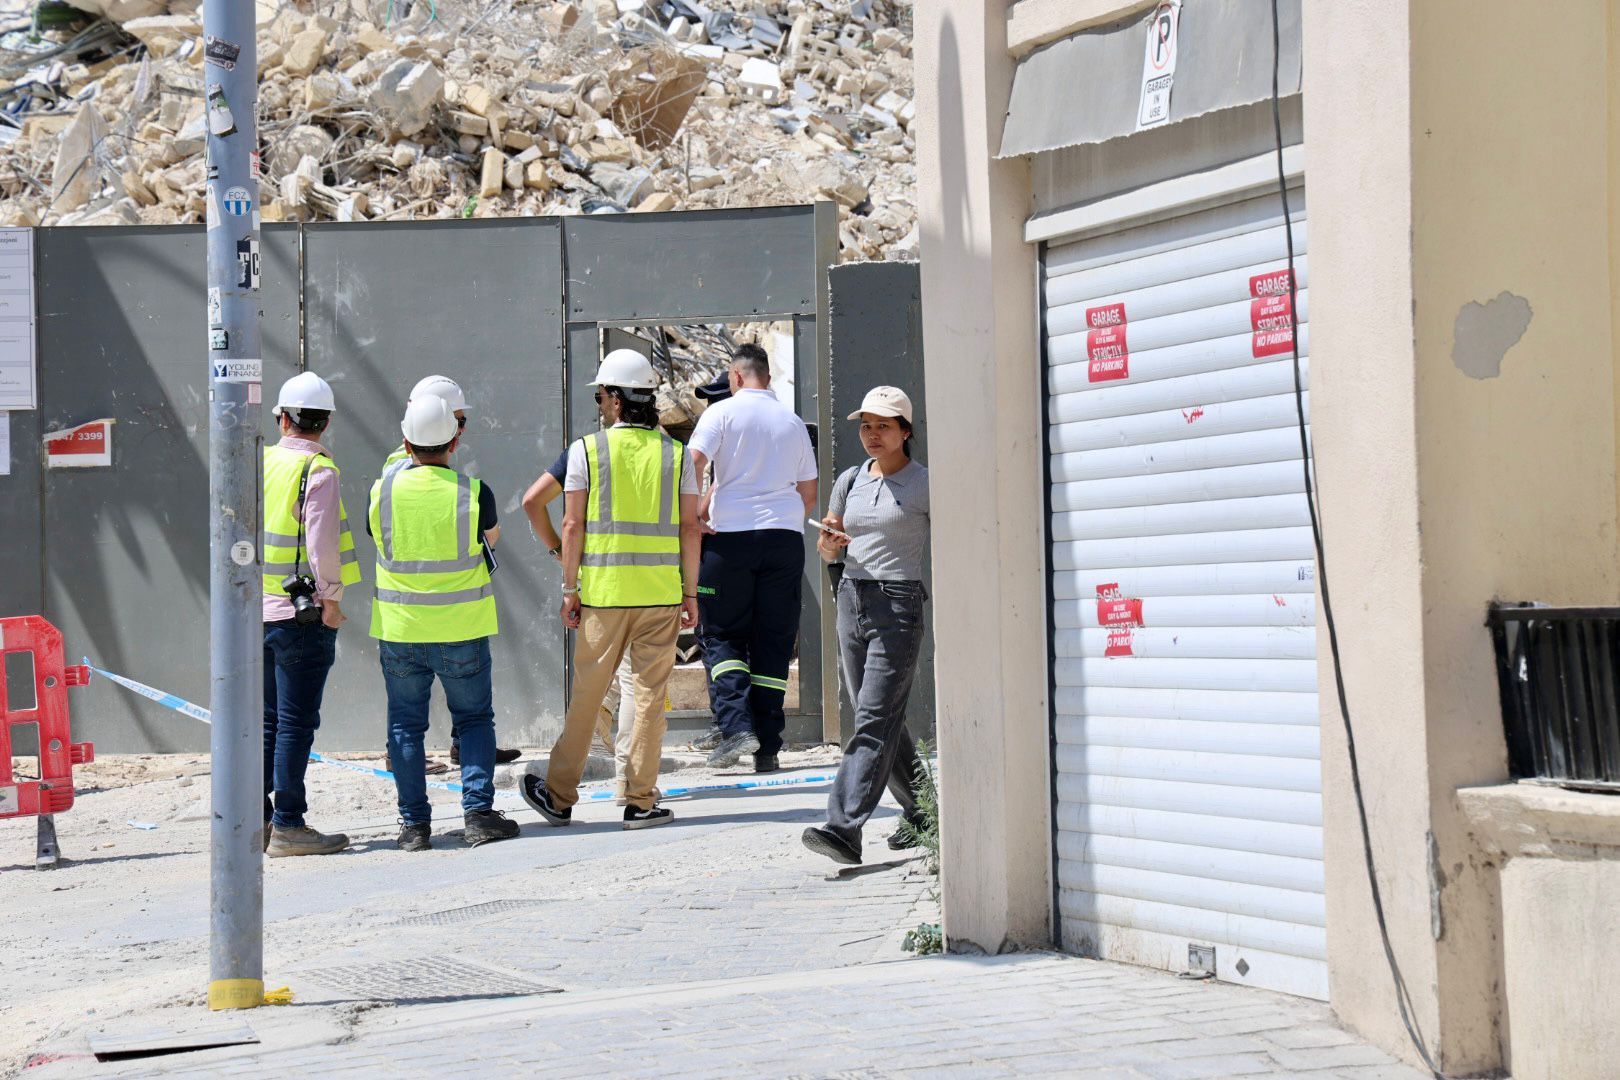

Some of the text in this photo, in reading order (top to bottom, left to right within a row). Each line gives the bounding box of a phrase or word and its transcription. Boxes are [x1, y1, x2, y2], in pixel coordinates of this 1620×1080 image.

[1153, 93, 1160, 104] IN
[1150, 106, 1161, 118] USE
[228, 191, 246, 200] FCZ
[1256, 275, 1290, 295] GARAGE
[1091, 309, 1121, 326] GARAGE
[1257, 314, 1292, 334] STRICTLY
[1256, 331, 1293, 348] NO PARKING
[1093, 345, 1122, 360] STRICTLY
[228, 363, 259, 371] YOUNG
[1092, 360, 1124, 373] NO PARKING
[78, 431, 103, 441] 3399
[1104, 588, 1122, 602] GAR
